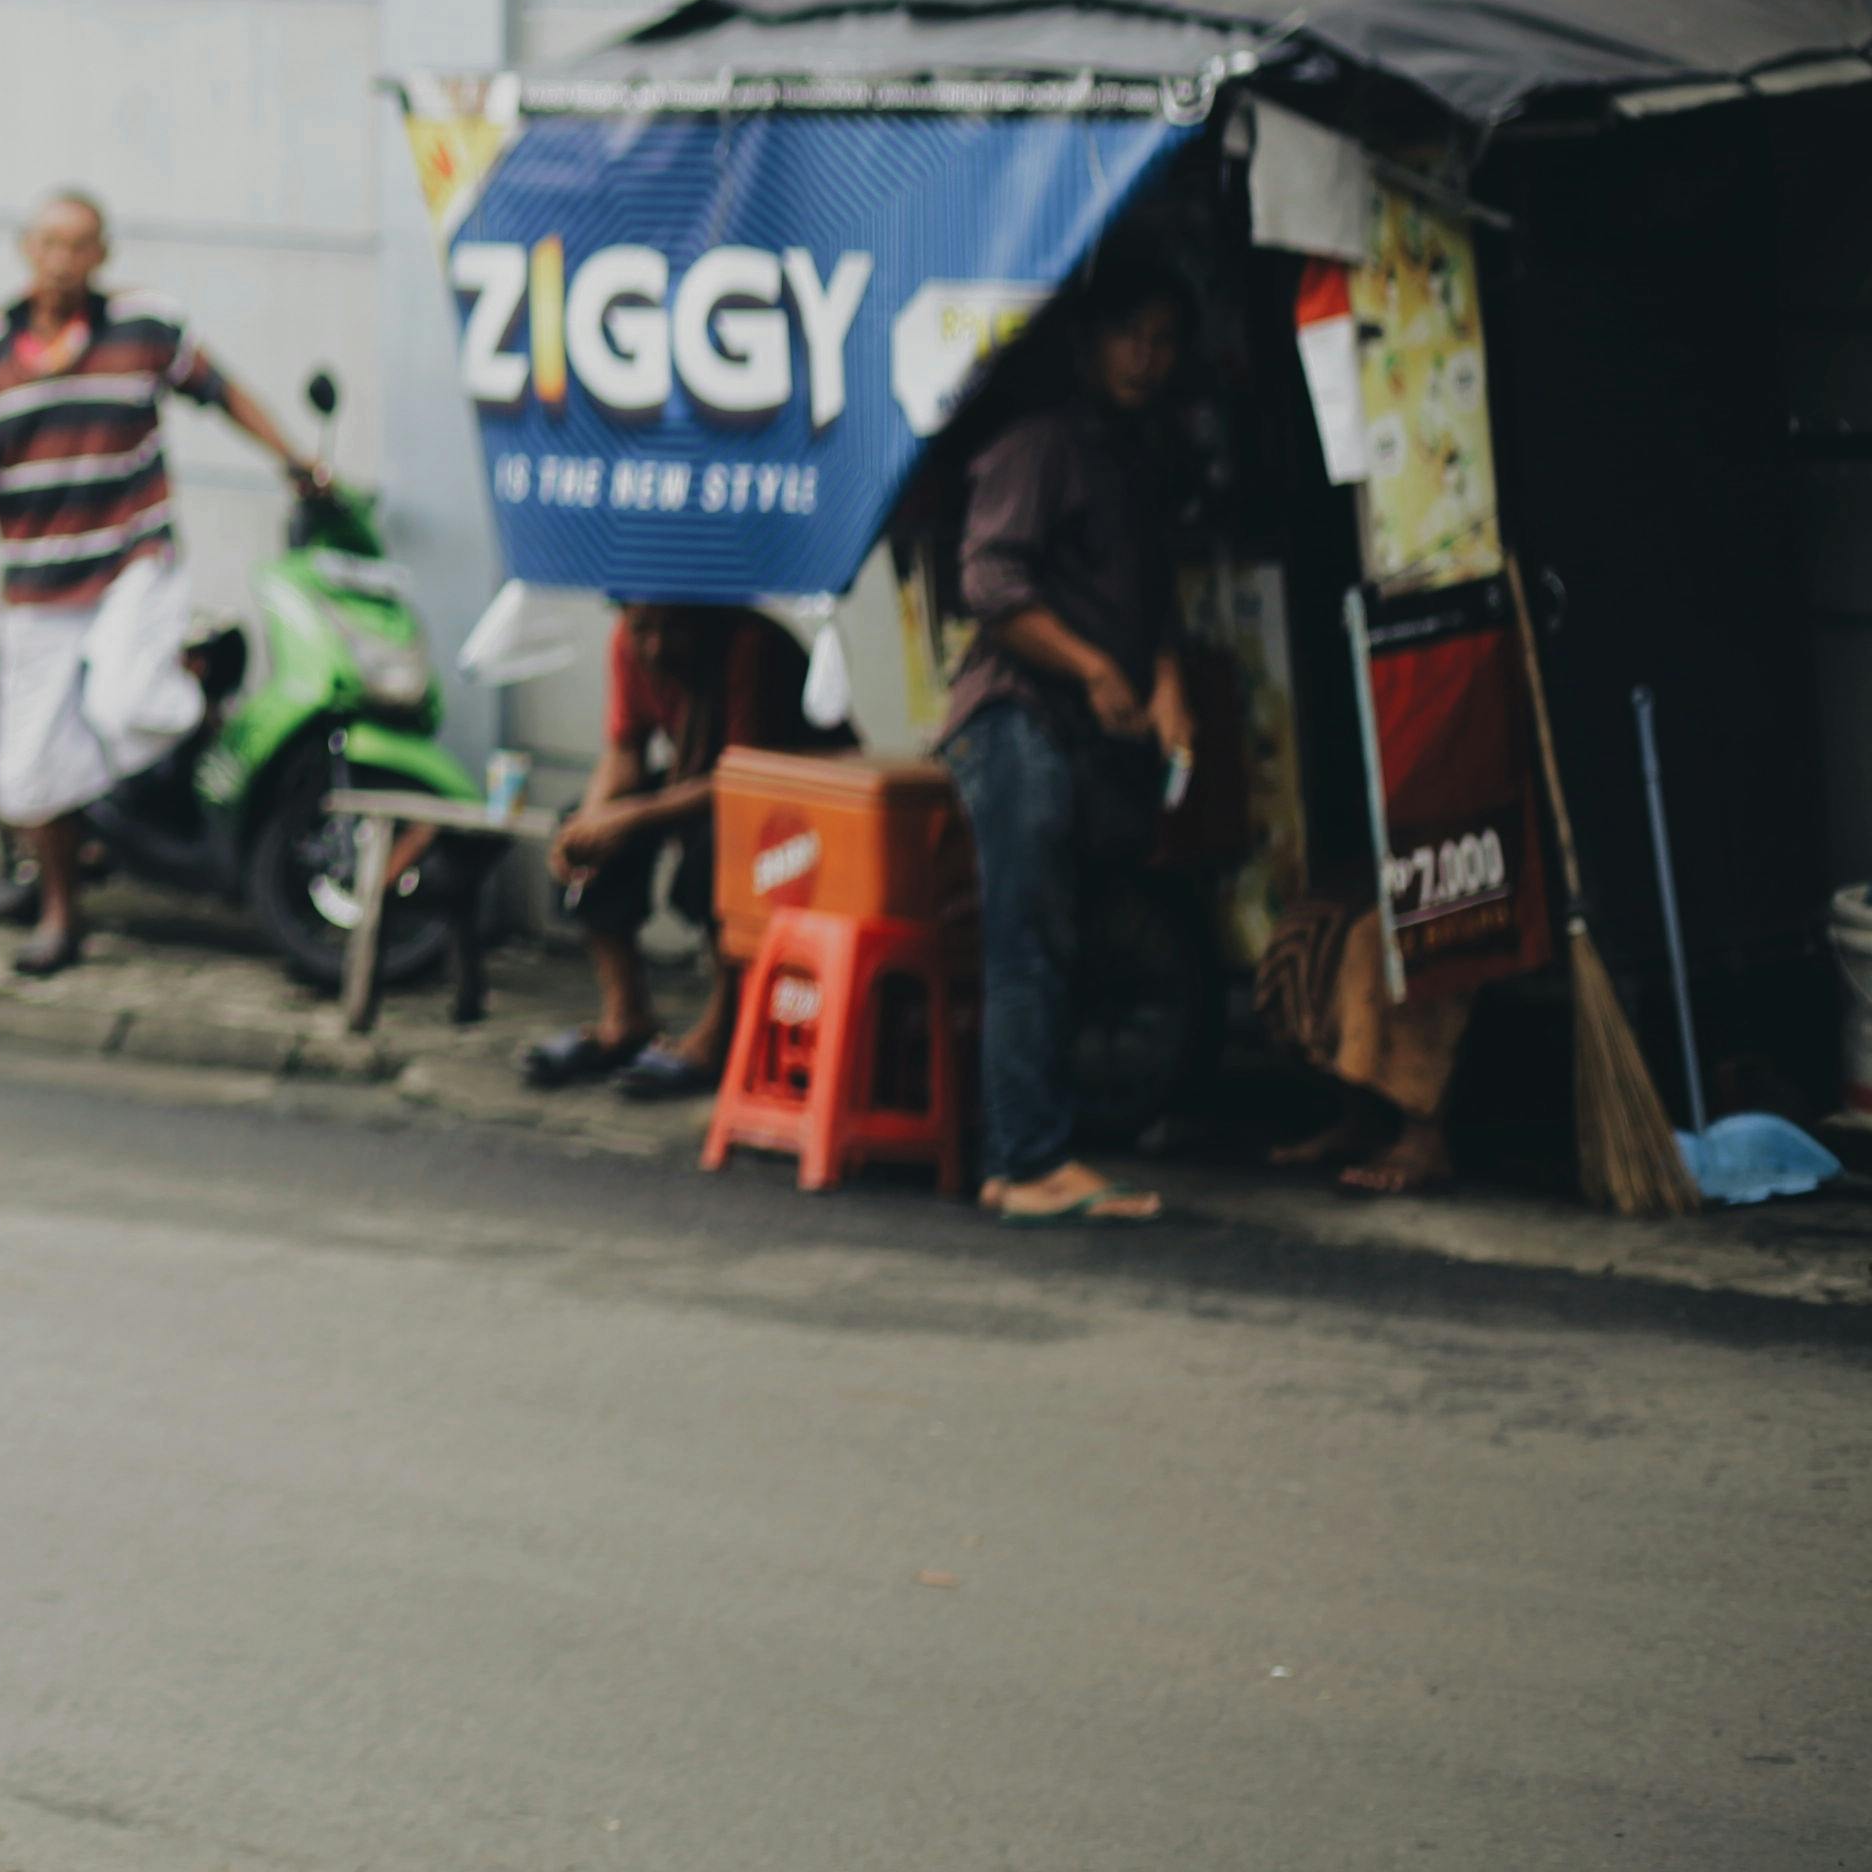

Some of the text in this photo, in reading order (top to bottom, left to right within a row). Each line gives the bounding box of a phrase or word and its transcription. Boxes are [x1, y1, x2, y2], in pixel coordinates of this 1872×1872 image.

[451, 234, 874, 428] ZIGGY
[538, 454, 604, 508] THE
[610, 458, 692, 511] NEW
[701, 461, 819, 515] STYLE
